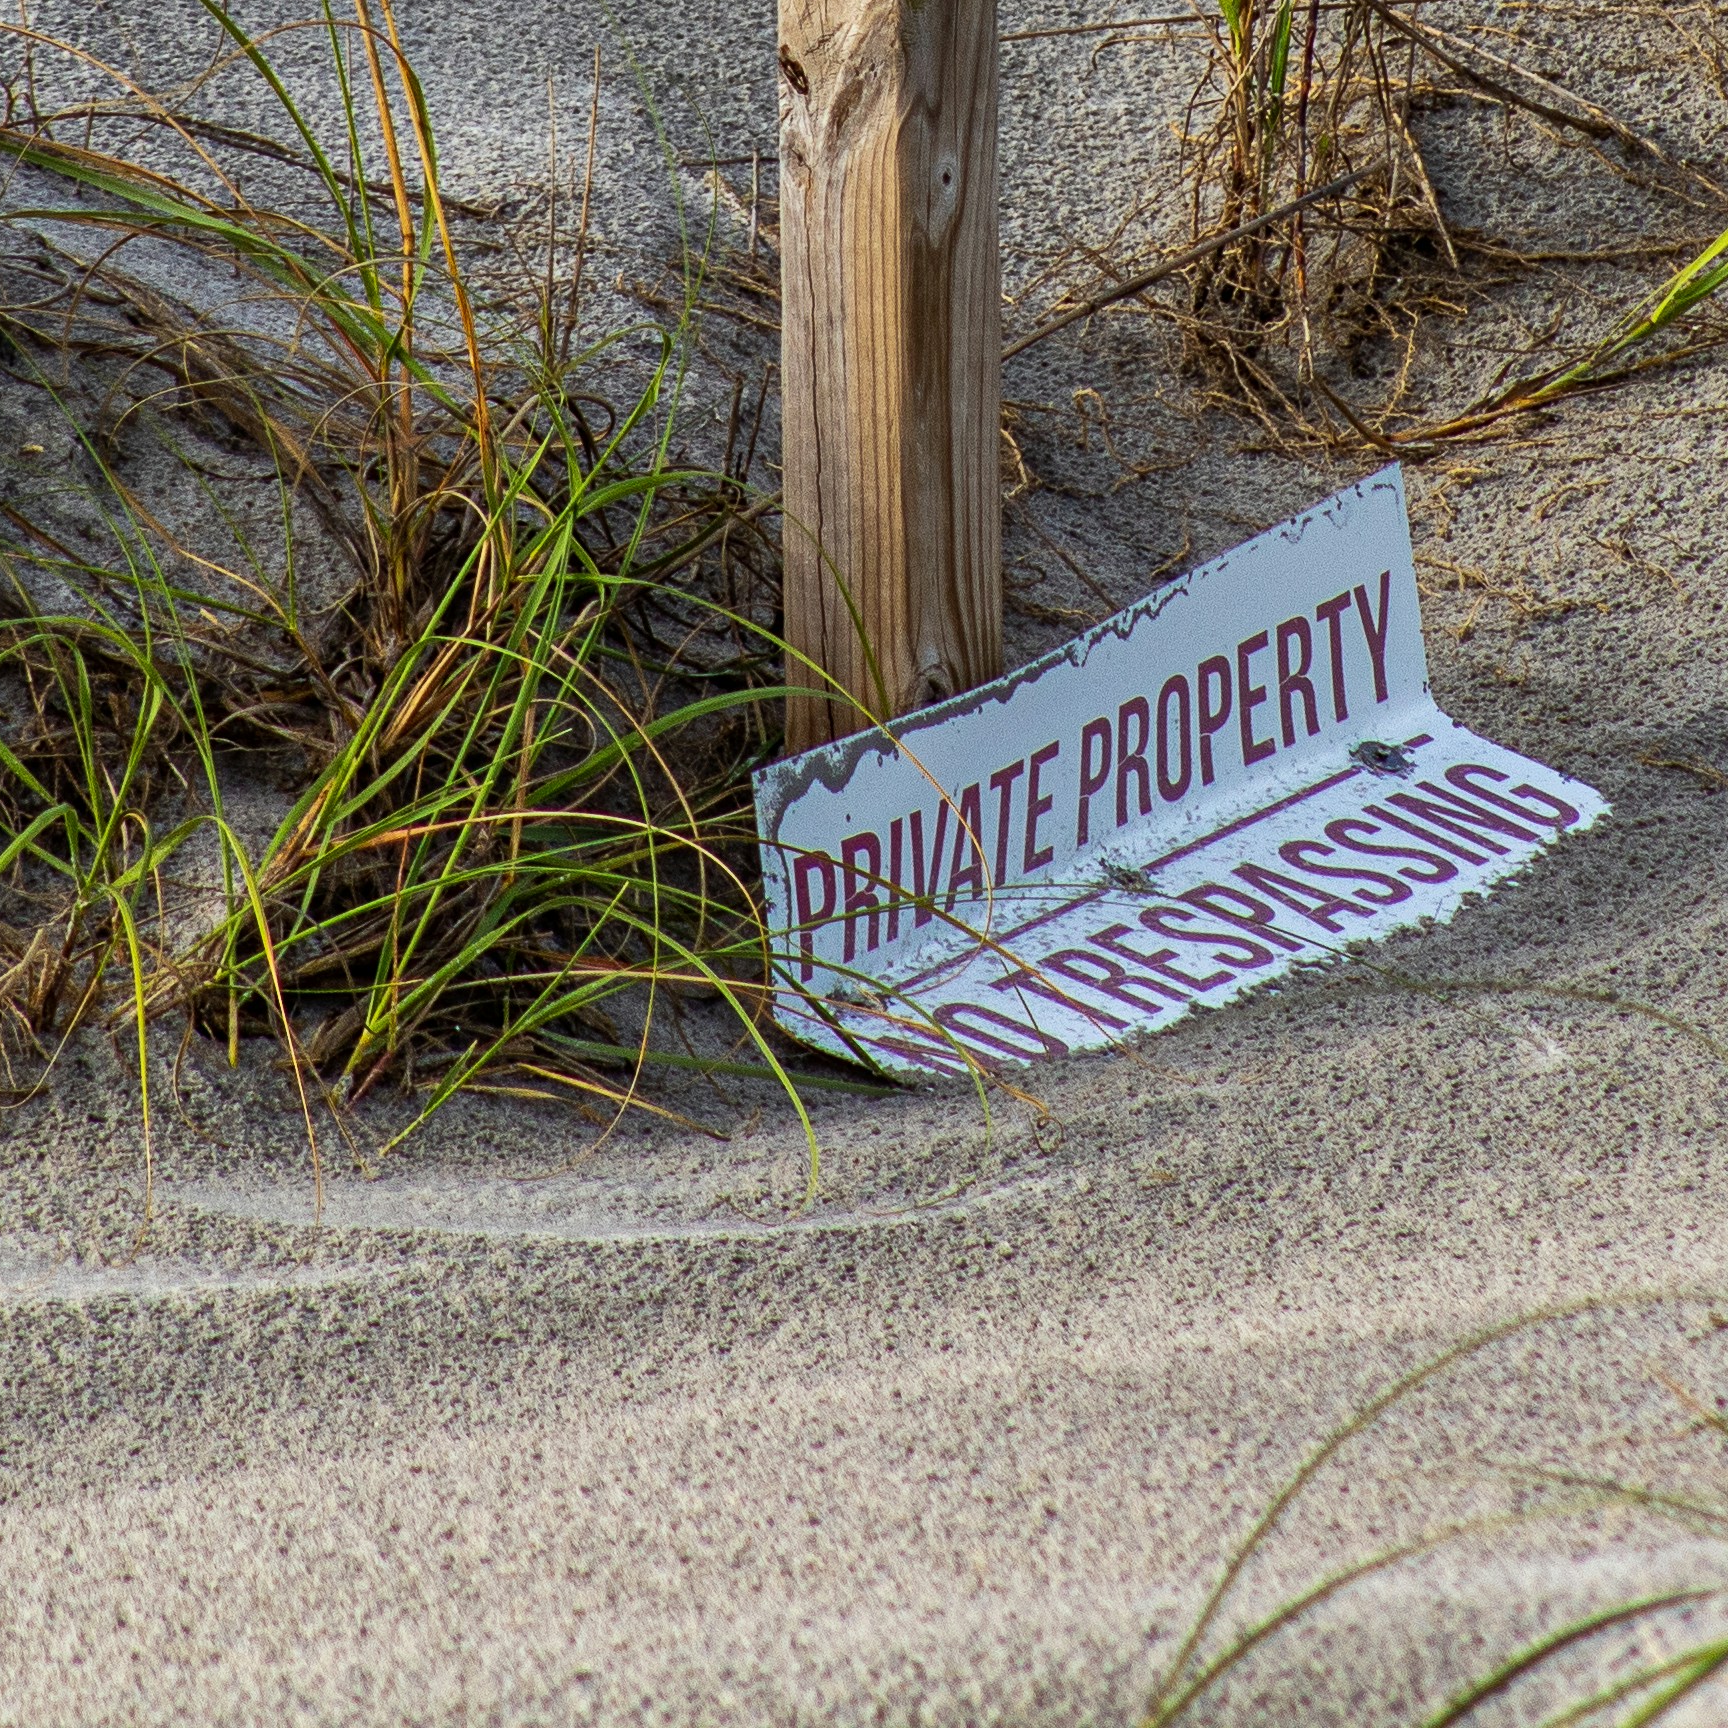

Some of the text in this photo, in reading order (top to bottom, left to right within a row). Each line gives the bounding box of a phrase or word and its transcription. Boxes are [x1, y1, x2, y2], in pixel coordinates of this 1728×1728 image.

[792, 570, 1392, 983] PRIVATE PROPERTY
[988, 763, 1581, 1029] TRESPASSING
